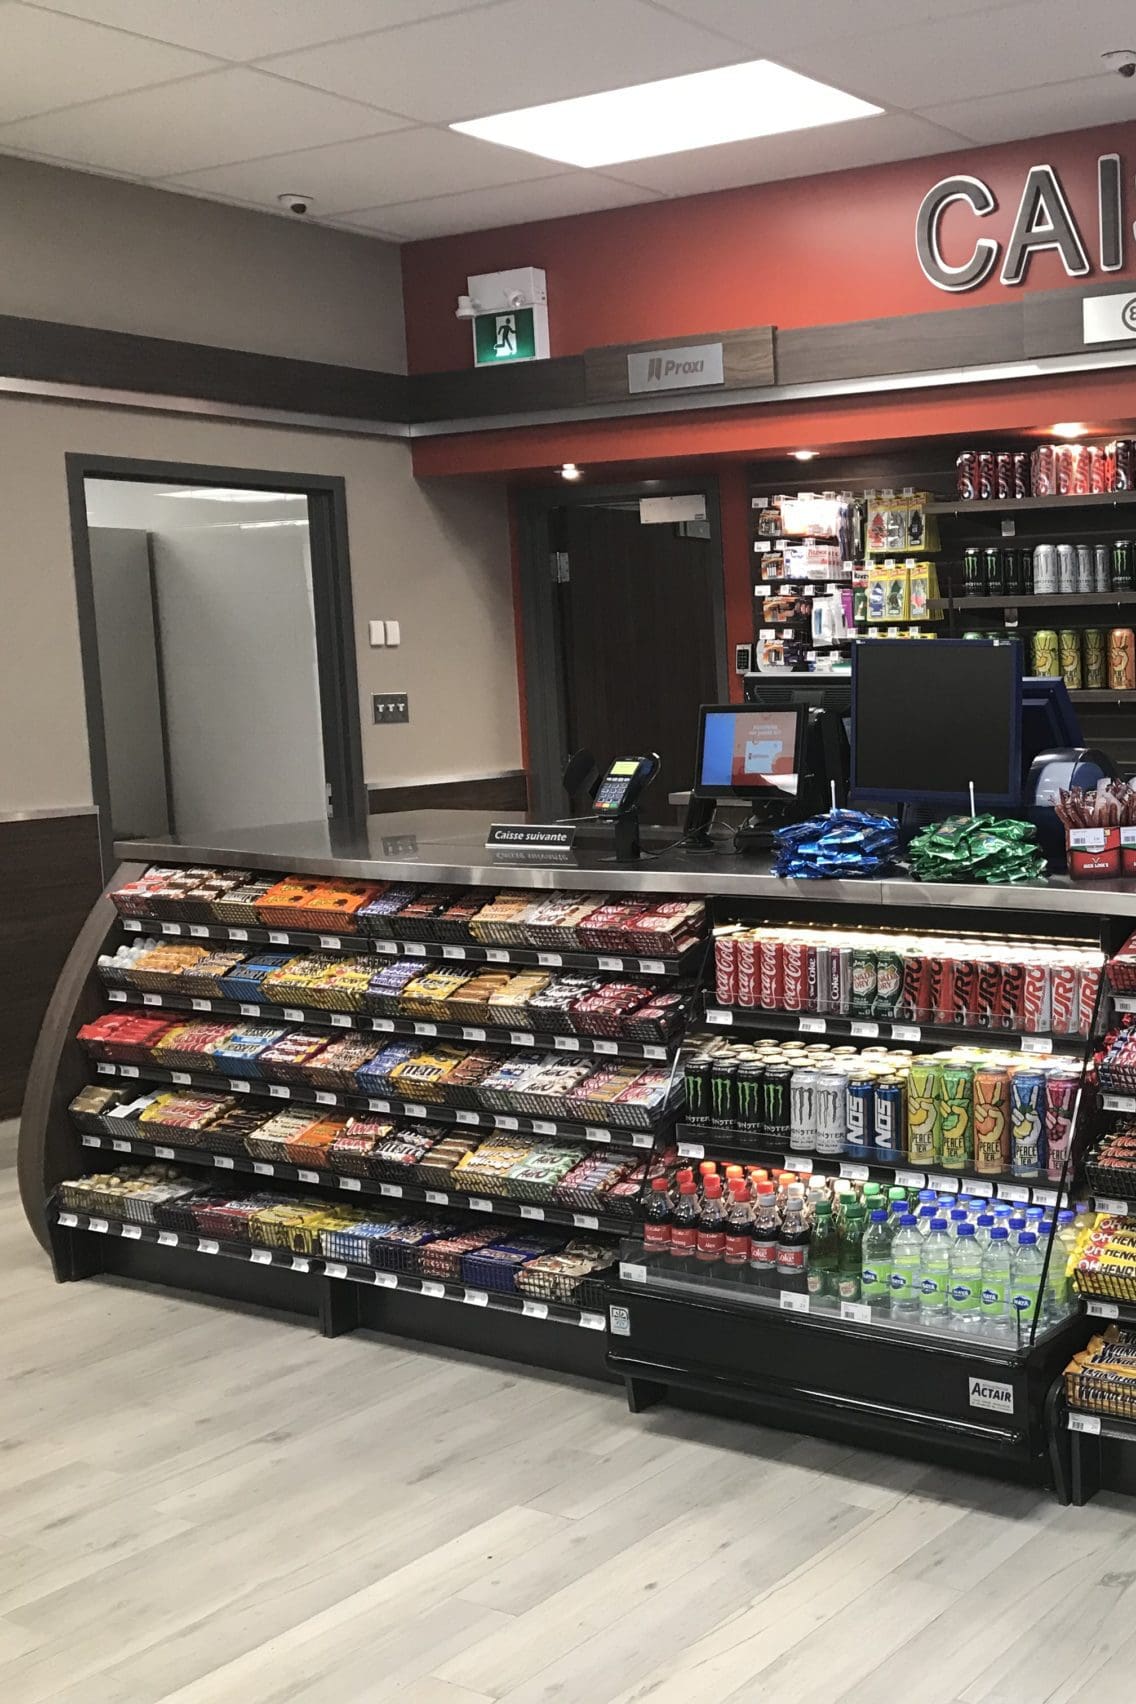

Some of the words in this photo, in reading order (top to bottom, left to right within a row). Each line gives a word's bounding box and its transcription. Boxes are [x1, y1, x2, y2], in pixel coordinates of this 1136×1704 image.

[664, 359, 704, 376] Proxi
[494, 830, 524, 841] Caisse
[525, 831, 567, 843] suivante
[847, 1094, 864, 1145] NOS
[875, 1096, 891, 1149] NOS
[912, 1134, 932, 1143] PEACE
[944, 1138, 963, 1148] PEACE
[979, 1142, 1000, 1152] PEACE
[1016, 1145, 1036, 1157] PEACE
[971, 1382, 1011, 1402] ACTAIR
